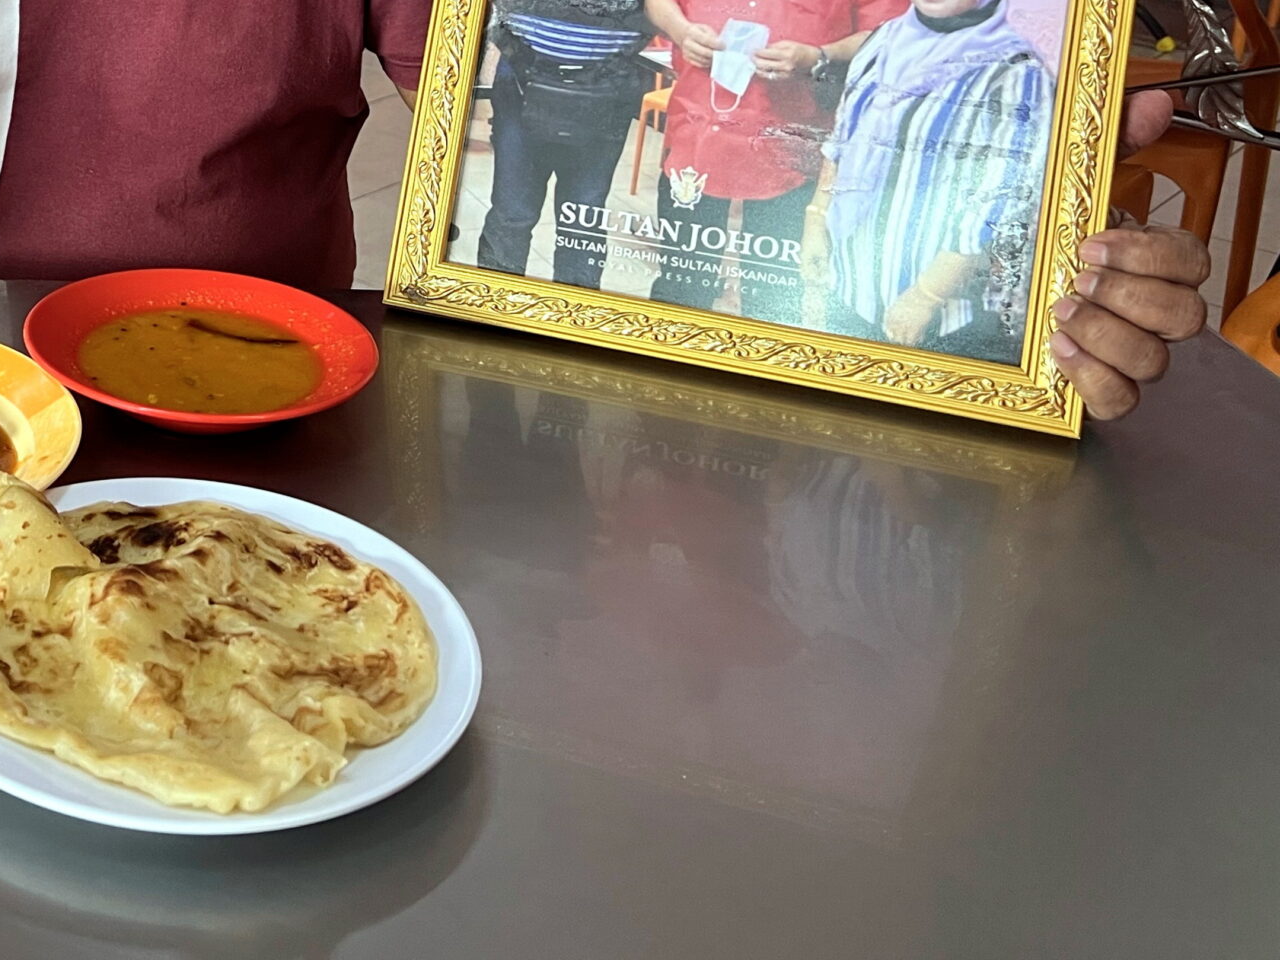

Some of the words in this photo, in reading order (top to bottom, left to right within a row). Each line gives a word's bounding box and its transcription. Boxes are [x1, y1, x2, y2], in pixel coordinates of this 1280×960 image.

[558, 201, 683, 243] SULTAN
[681, 223, 802, 264] JOHOR
[556, 236, 608, 254] SULTAN
[609, 245, 668, 265] IBRAHIM
[670, 256, 723, 275] SULTAN
[726, 266, 798, 288] ISKANDAR
[701, 278, 758, 296] OFFICE
